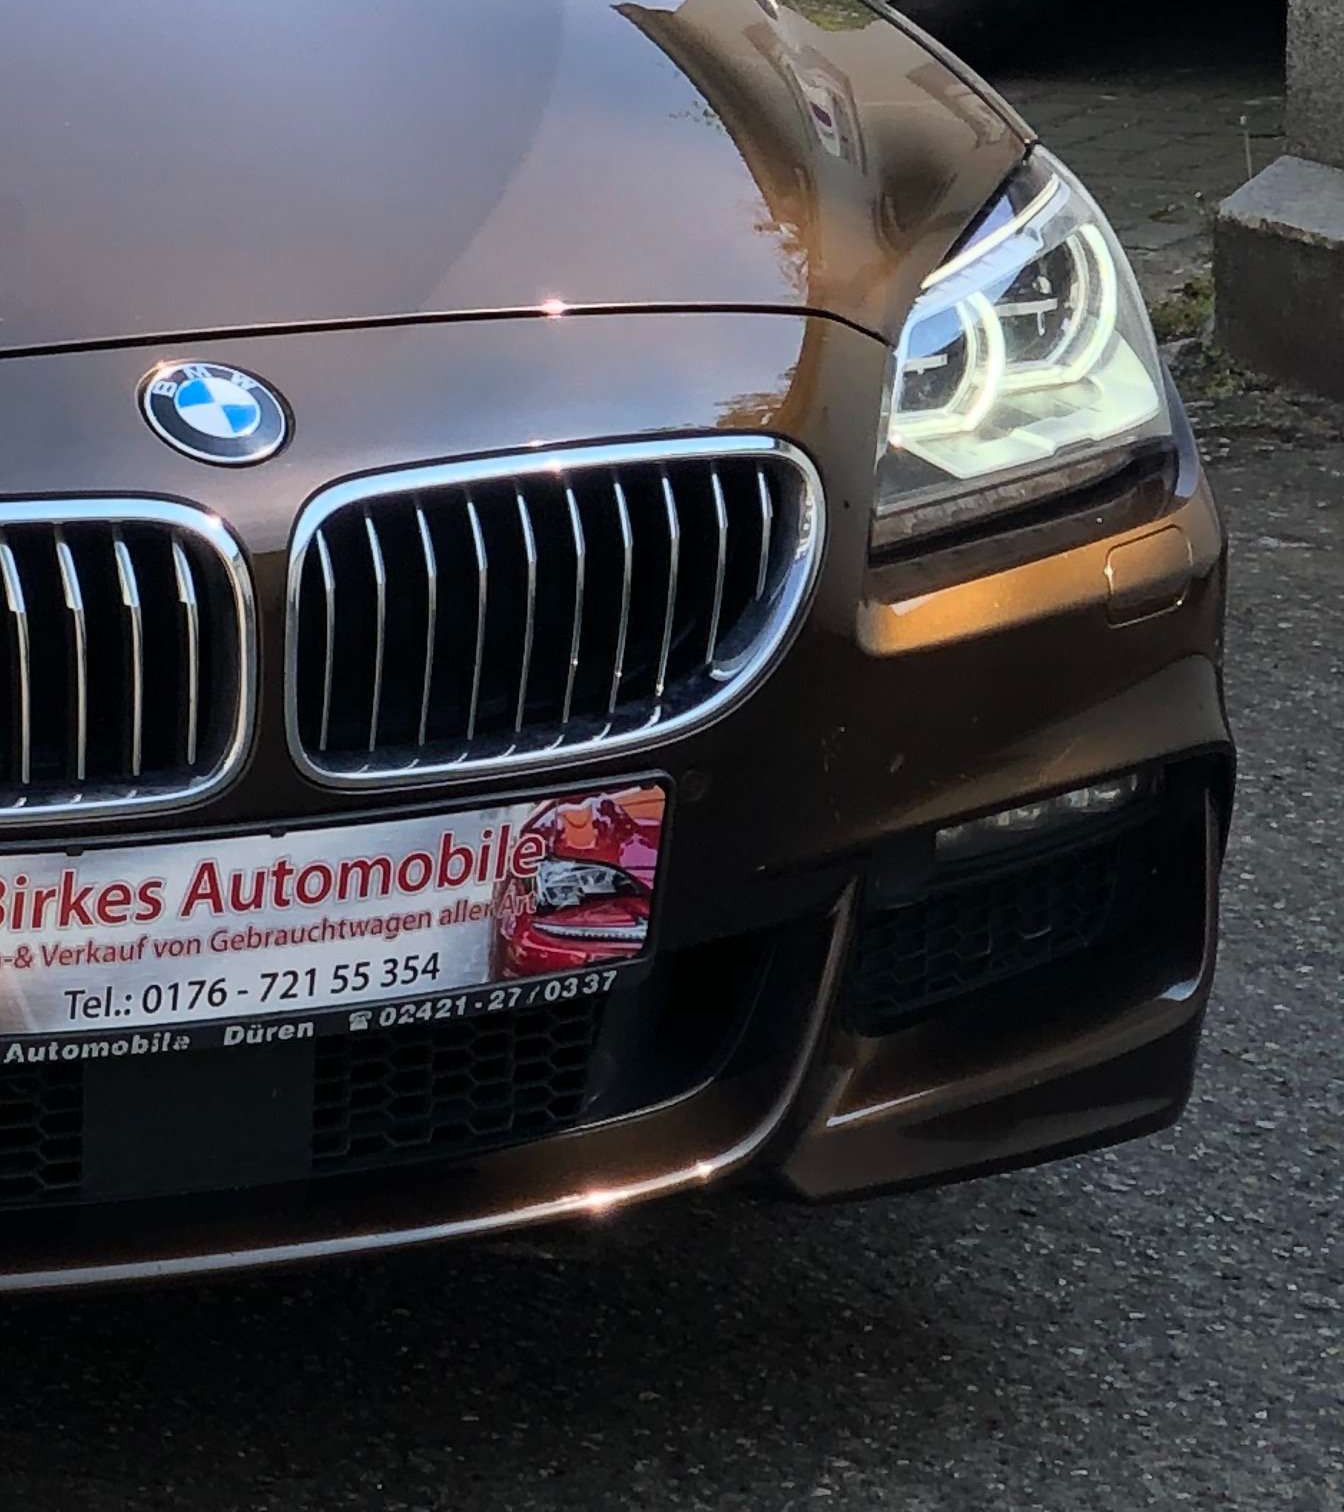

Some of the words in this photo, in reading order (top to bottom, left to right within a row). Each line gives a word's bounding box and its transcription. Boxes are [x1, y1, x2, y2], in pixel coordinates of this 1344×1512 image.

[152, 365, 258, 398] BMW
[179, 824, 546, 917] Automobile
[40, 935, 148, 968] Verkauf
[154, 938, 201, 958] von
[210, 910, 432, 953] Gebrauchtwagen
[439, 898, 495, 925] aller
[497, 890, 537, 916] Art
[64, 986, 132, 1021] Tel.:
[141, 977, 228, 1014] 0176
[260, 967, 317, 1003] 721
[329, 961, 371, 995] 55
[380, 951, 441, 988] 354
[223, 1021, 315, 1047] Düren
